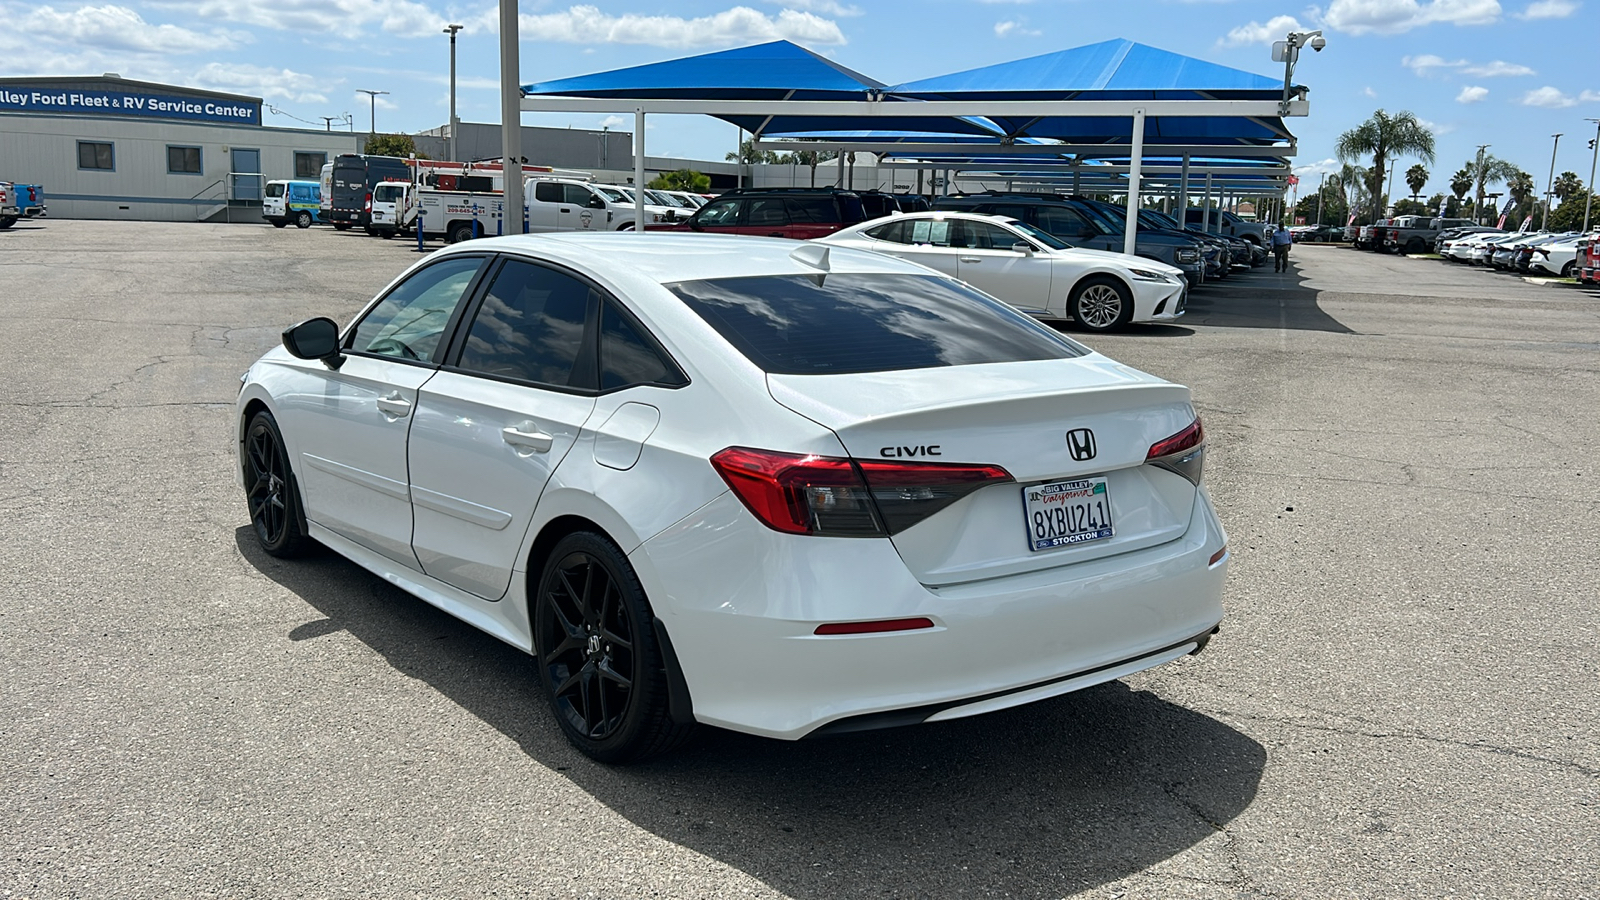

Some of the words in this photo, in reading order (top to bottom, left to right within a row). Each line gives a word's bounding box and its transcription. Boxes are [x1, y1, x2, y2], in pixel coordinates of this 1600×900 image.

[31, 92, 67, 106] Ford
[70, 94, 109, 107] Fleet
[112, 99, 120, 108] &
[123, 96, 145, 109] RV
[148, 98, 203, 114] Service
[204, 103, 253, 118] Center
[880, 445, 942, 458] CIVIC
[1060, 481, 1089, 490] VALLEY
[1034, 501, 1108, 538] 8XBU241
[1052, 532, 1098, 546] STOCKTON
